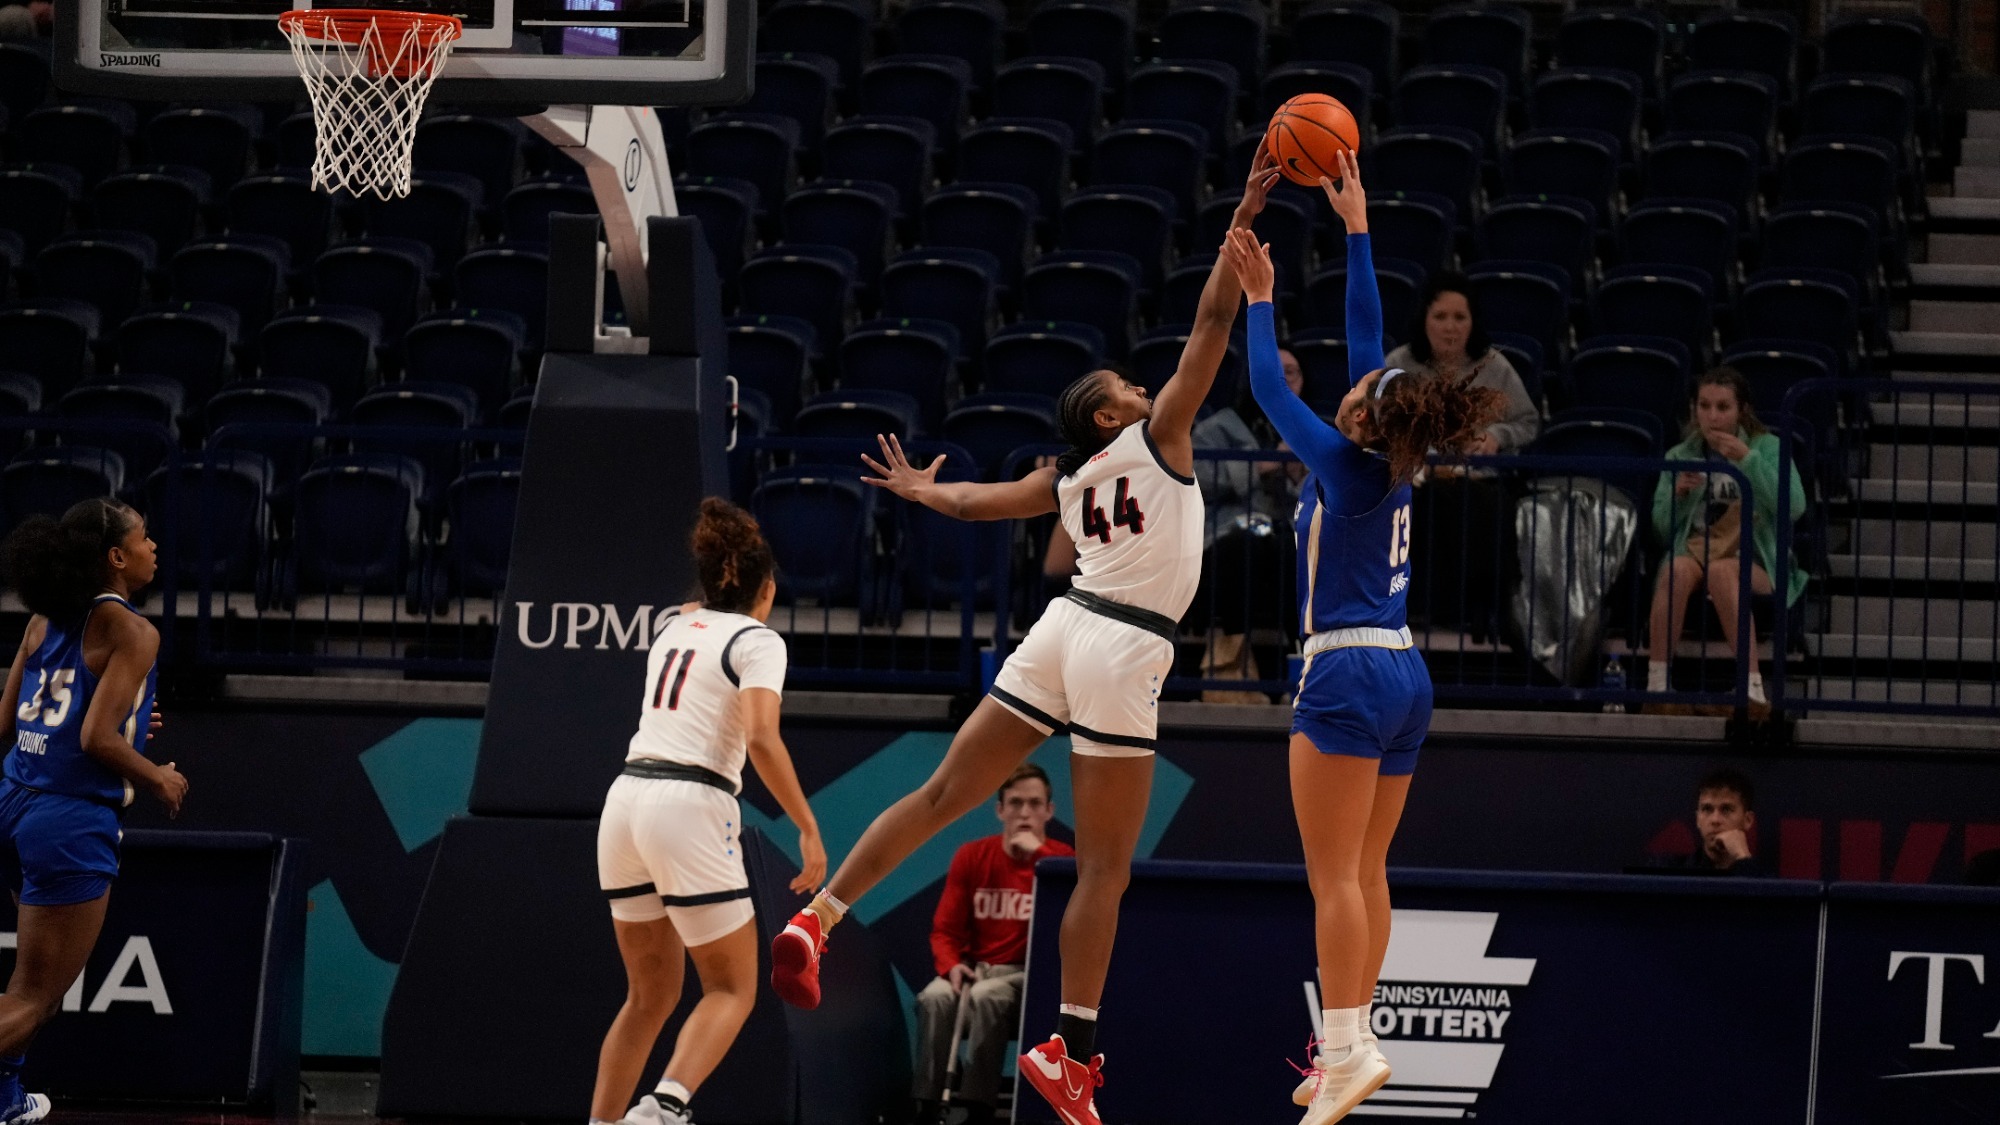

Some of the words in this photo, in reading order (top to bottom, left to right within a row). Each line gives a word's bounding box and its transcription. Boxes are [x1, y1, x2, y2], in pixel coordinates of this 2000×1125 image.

[100, 53, 160, 67] SPALDING
[1082, 476, 1145, 544] 44
[1389, 504, 1410, 567] 13
[17, 667, 76, 727] 35
[652, 648, 696, 710] 11
[17, 729, 49, 756] YOUNG
[1371, 1005, 1512, 1039] OTTERY
[1372, 984, 1512, 1008] ENNSYLVANIA
[1887, 950, 2000, 1050] T
